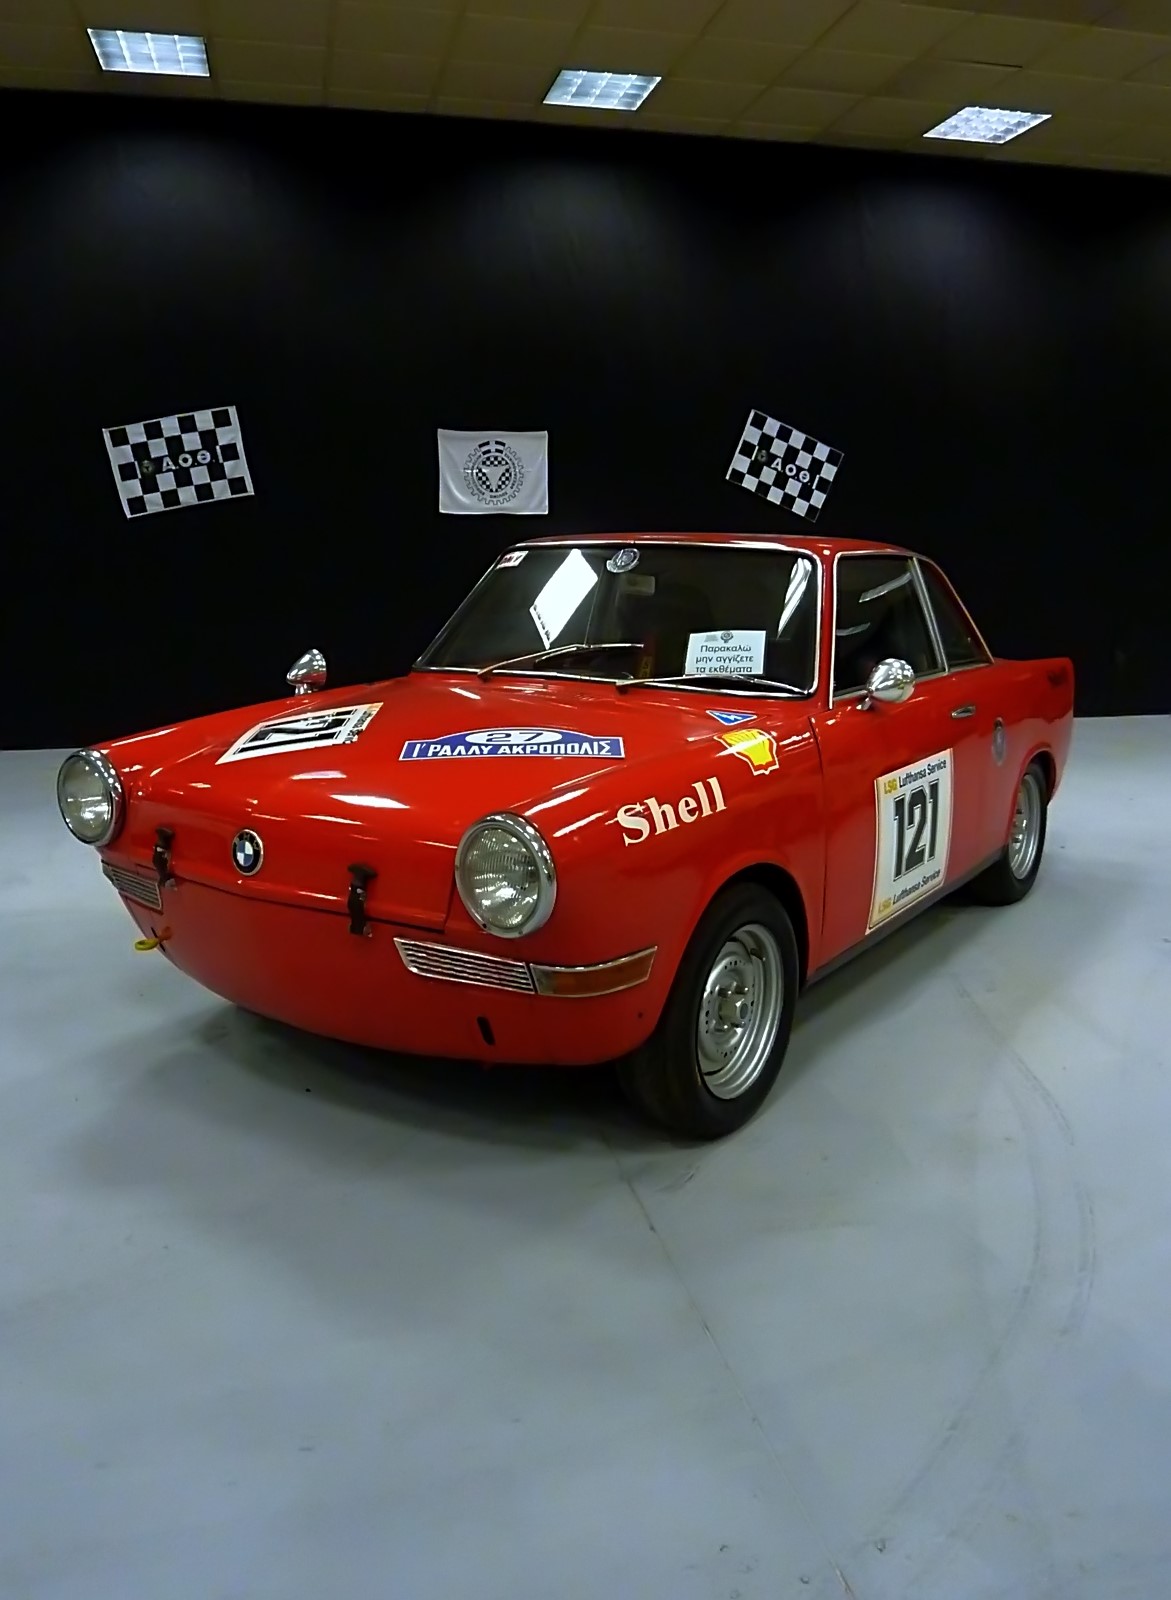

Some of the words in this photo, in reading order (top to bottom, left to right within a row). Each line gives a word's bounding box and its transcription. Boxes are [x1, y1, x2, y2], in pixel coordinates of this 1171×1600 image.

[700, 644, 752, 654] Παρακαλώ
[695, 656, 714, 664] μην
[715, 654, 754, 665] αγγίζετε
[708, 664, 753, 674] εκθέματα
[485, 731, 545, 743] 27
[427, 744, 494, 757] ΡΑΛΛΥ
[496, 740, 612, 756] ΑΚΡΟΠΟΛΙΣ
[899, 769, 926, 788] Lufthansa
[926, 759, 947, 776] Service
[616, 776, 727, 847] Shell
[893, 778, 939, 882] 121
